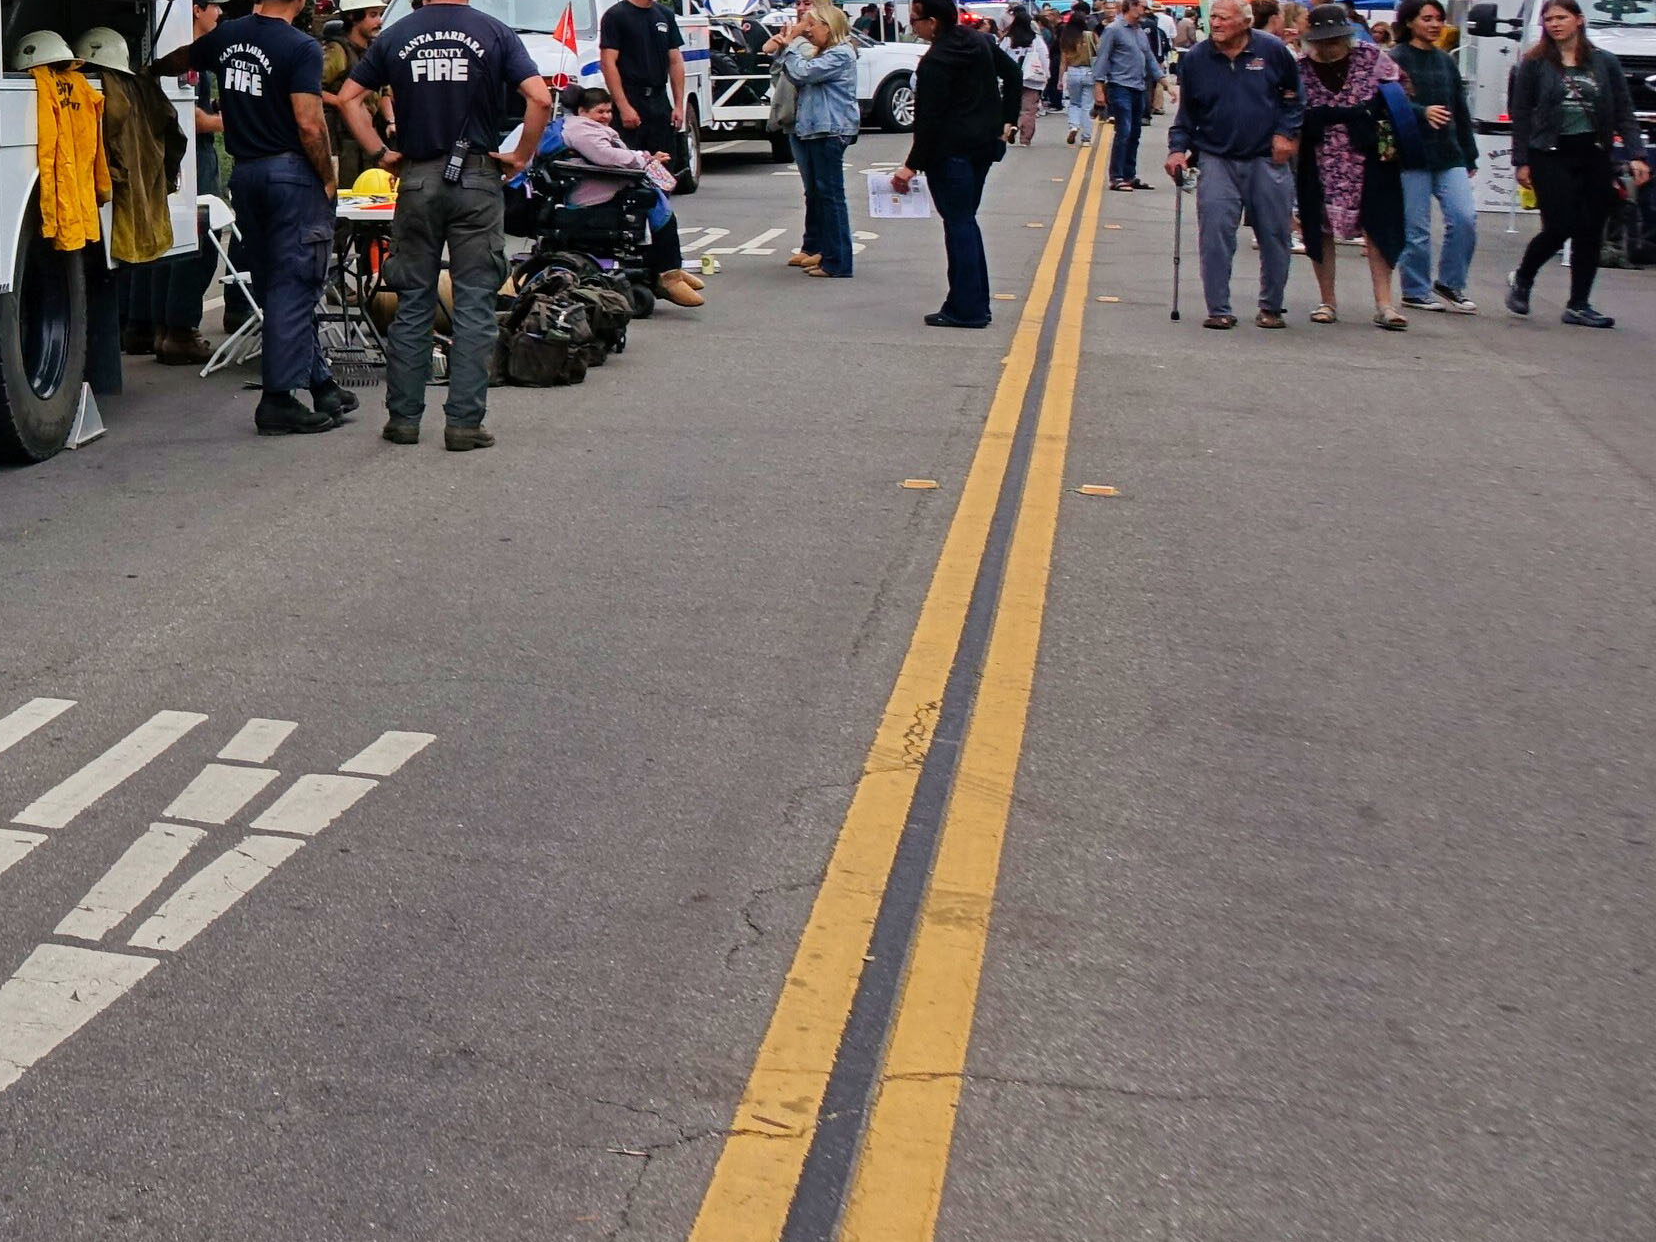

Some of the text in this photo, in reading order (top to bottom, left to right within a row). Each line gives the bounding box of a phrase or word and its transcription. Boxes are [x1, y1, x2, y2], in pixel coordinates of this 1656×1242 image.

[399, 30, 485, 60] SANTA BARBARA
[417, 48, 464, 59] COUNTY
[224, 67, 263, 97] FIRE
[410, 58, 469, 82] FIRE
